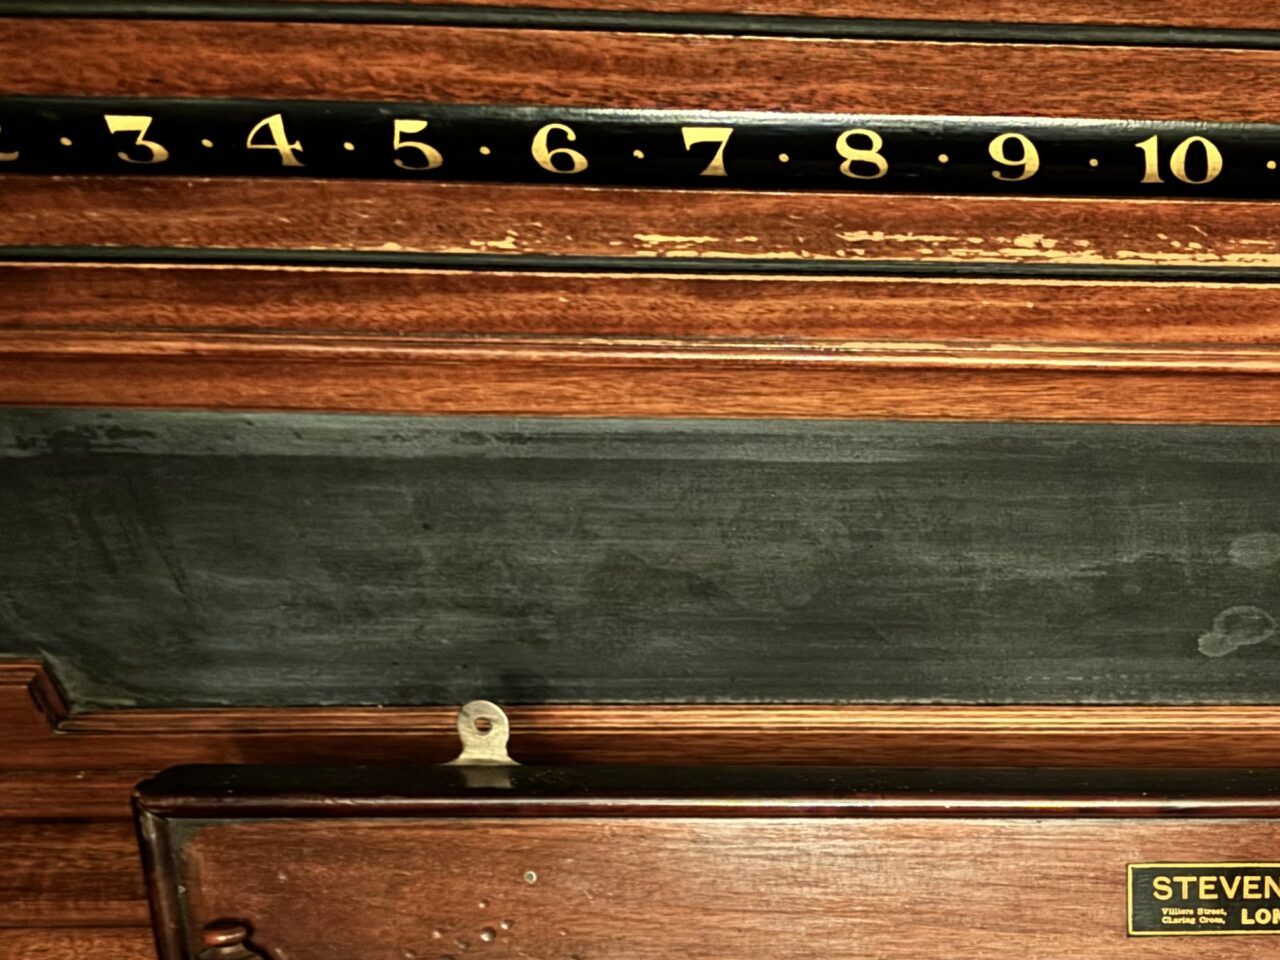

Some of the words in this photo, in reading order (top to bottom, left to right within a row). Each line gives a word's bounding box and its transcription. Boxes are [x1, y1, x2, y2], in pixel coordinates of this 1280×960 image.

[103, 113, 169, 165] 3
[246, 112, 304, 167] 4
[393, 118, 443, 170] 5
[531, 122, 589, 174] 6
[681, 126, 735, 177] 7
[835, 128, 890, 179] 8
[988, 132, 1041, 181] 9
[1134, 135, 1223, 184] 10
